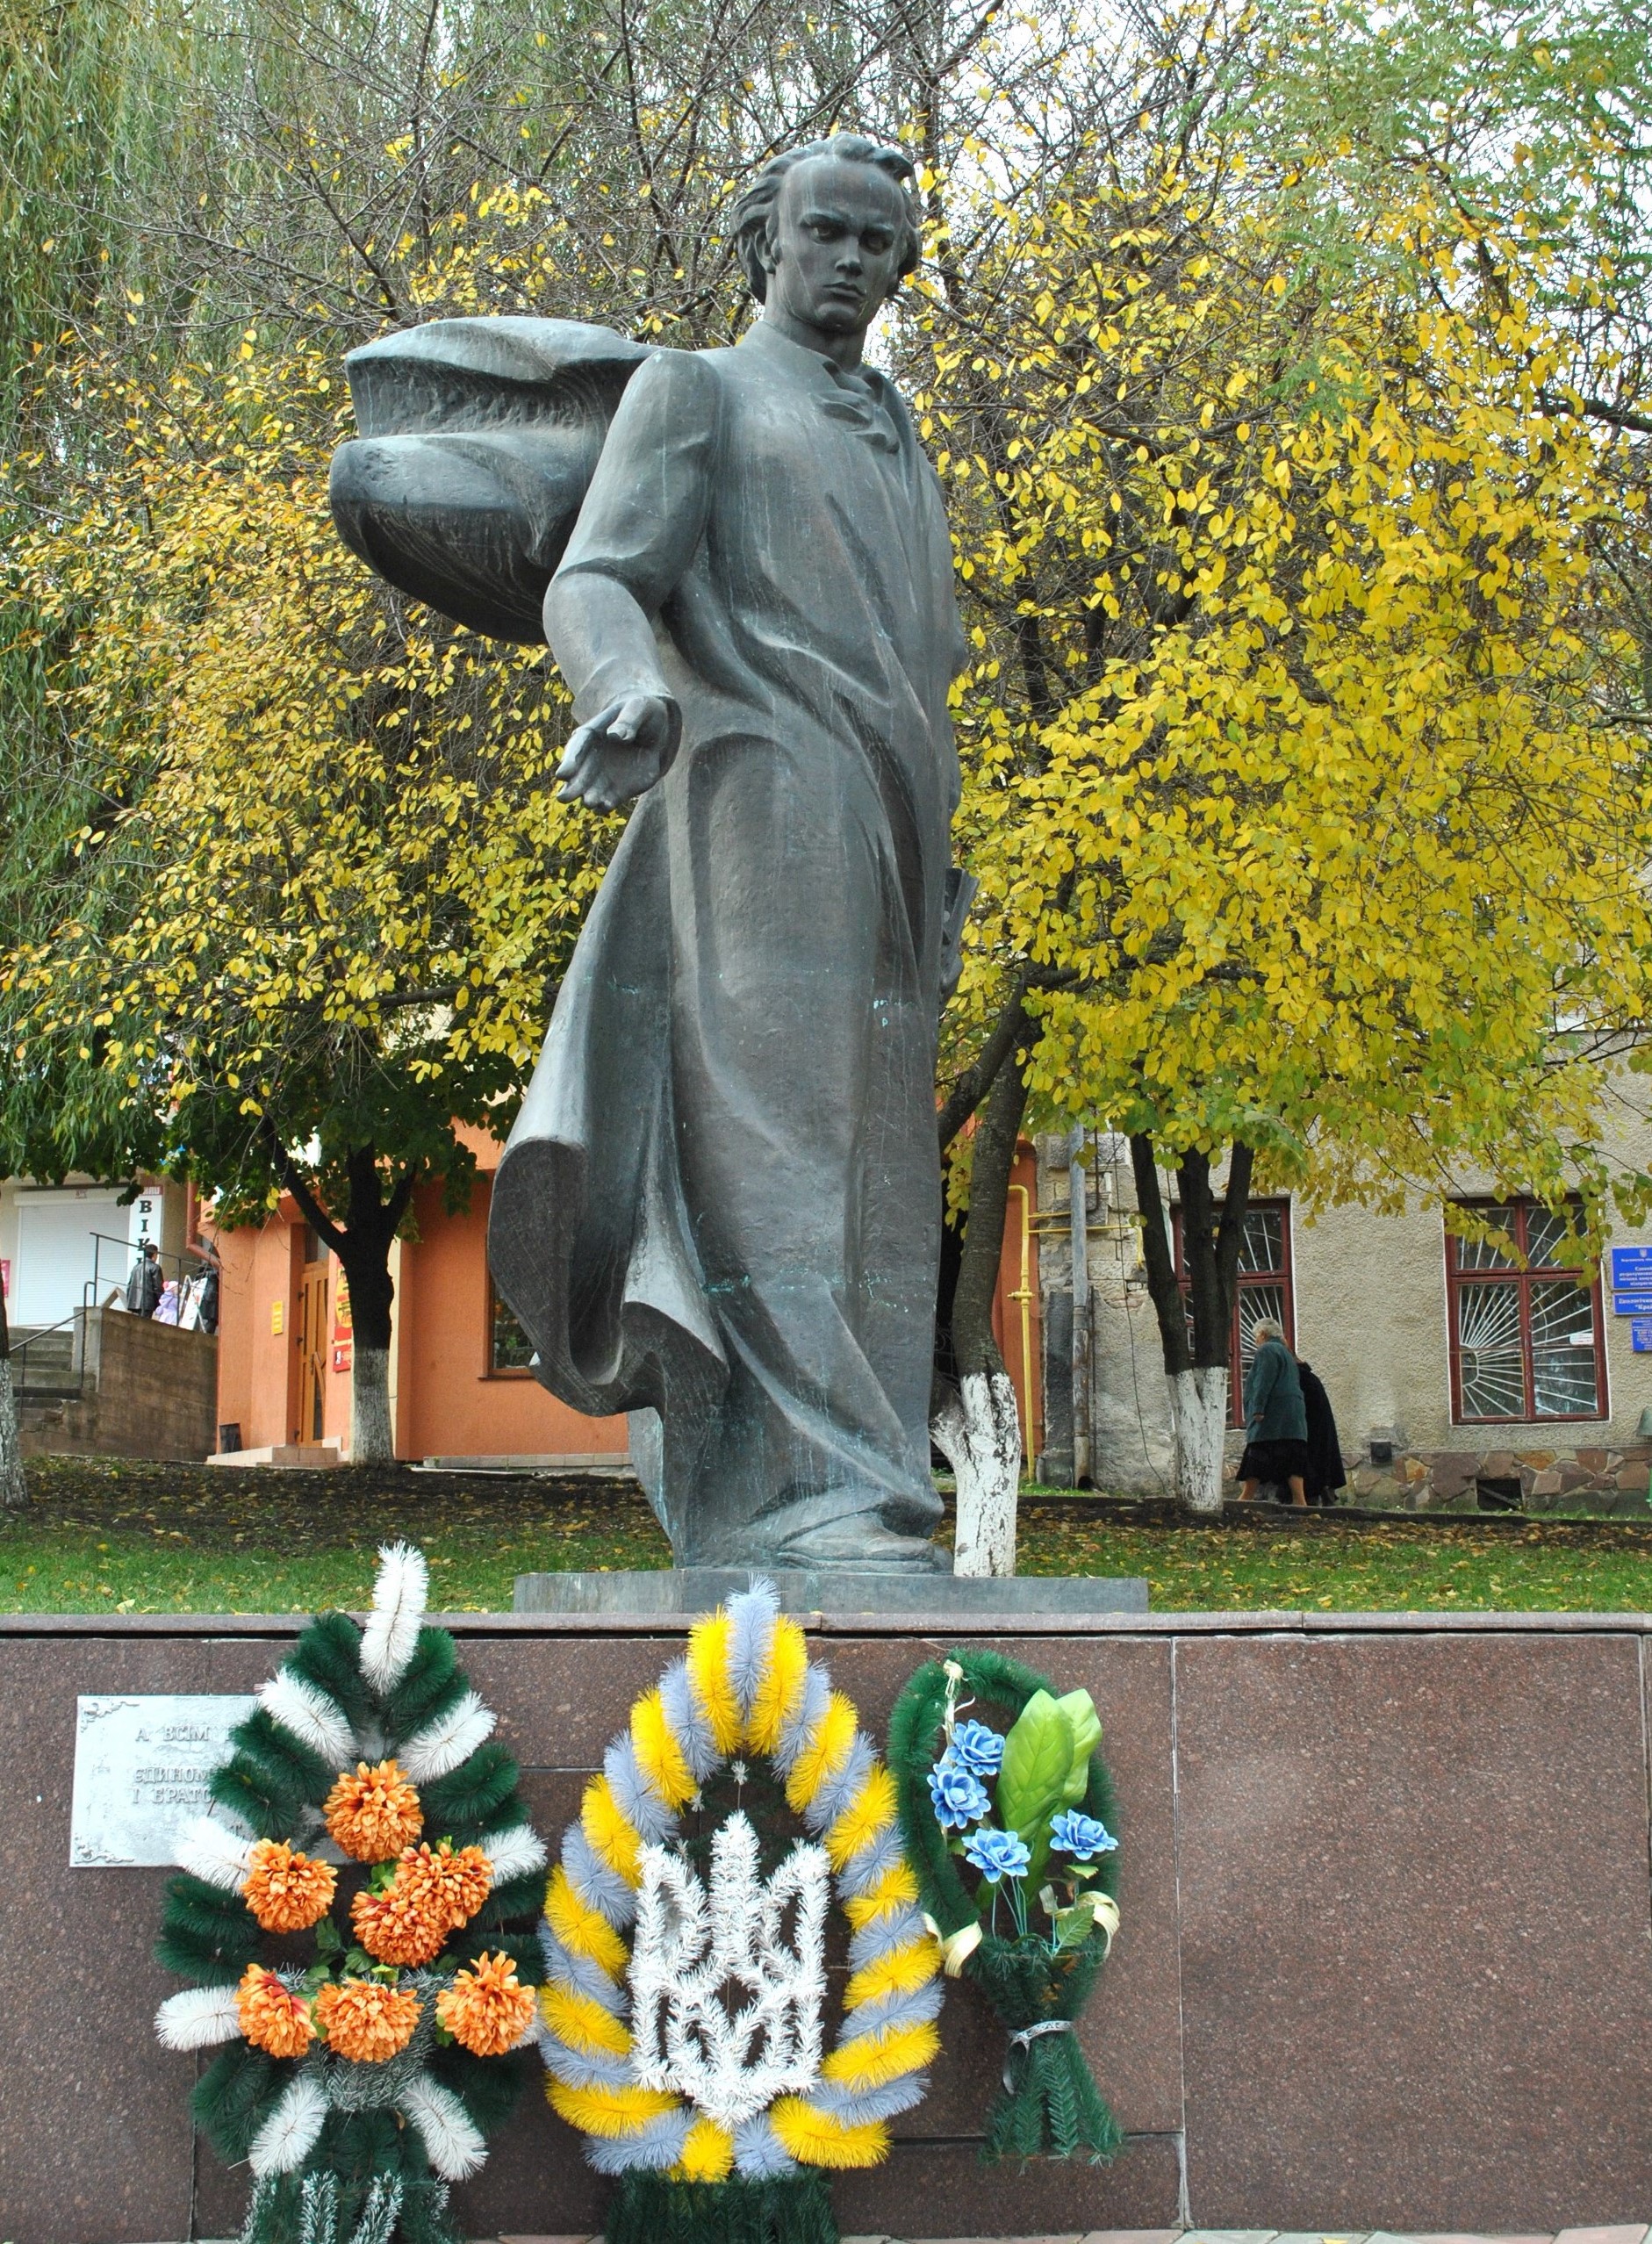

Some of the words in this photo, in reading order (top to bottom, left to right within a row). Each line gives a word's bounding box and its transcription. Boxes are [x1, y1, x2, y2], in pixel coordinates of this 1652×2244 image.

[135, 1727, 149, 1742] А
[163, 1725, 210, 1742] ВСІМ
[135, 1766, 212, 1784] ЄДИНОМ
[152, 1786, 212, 1804] БРАТО
